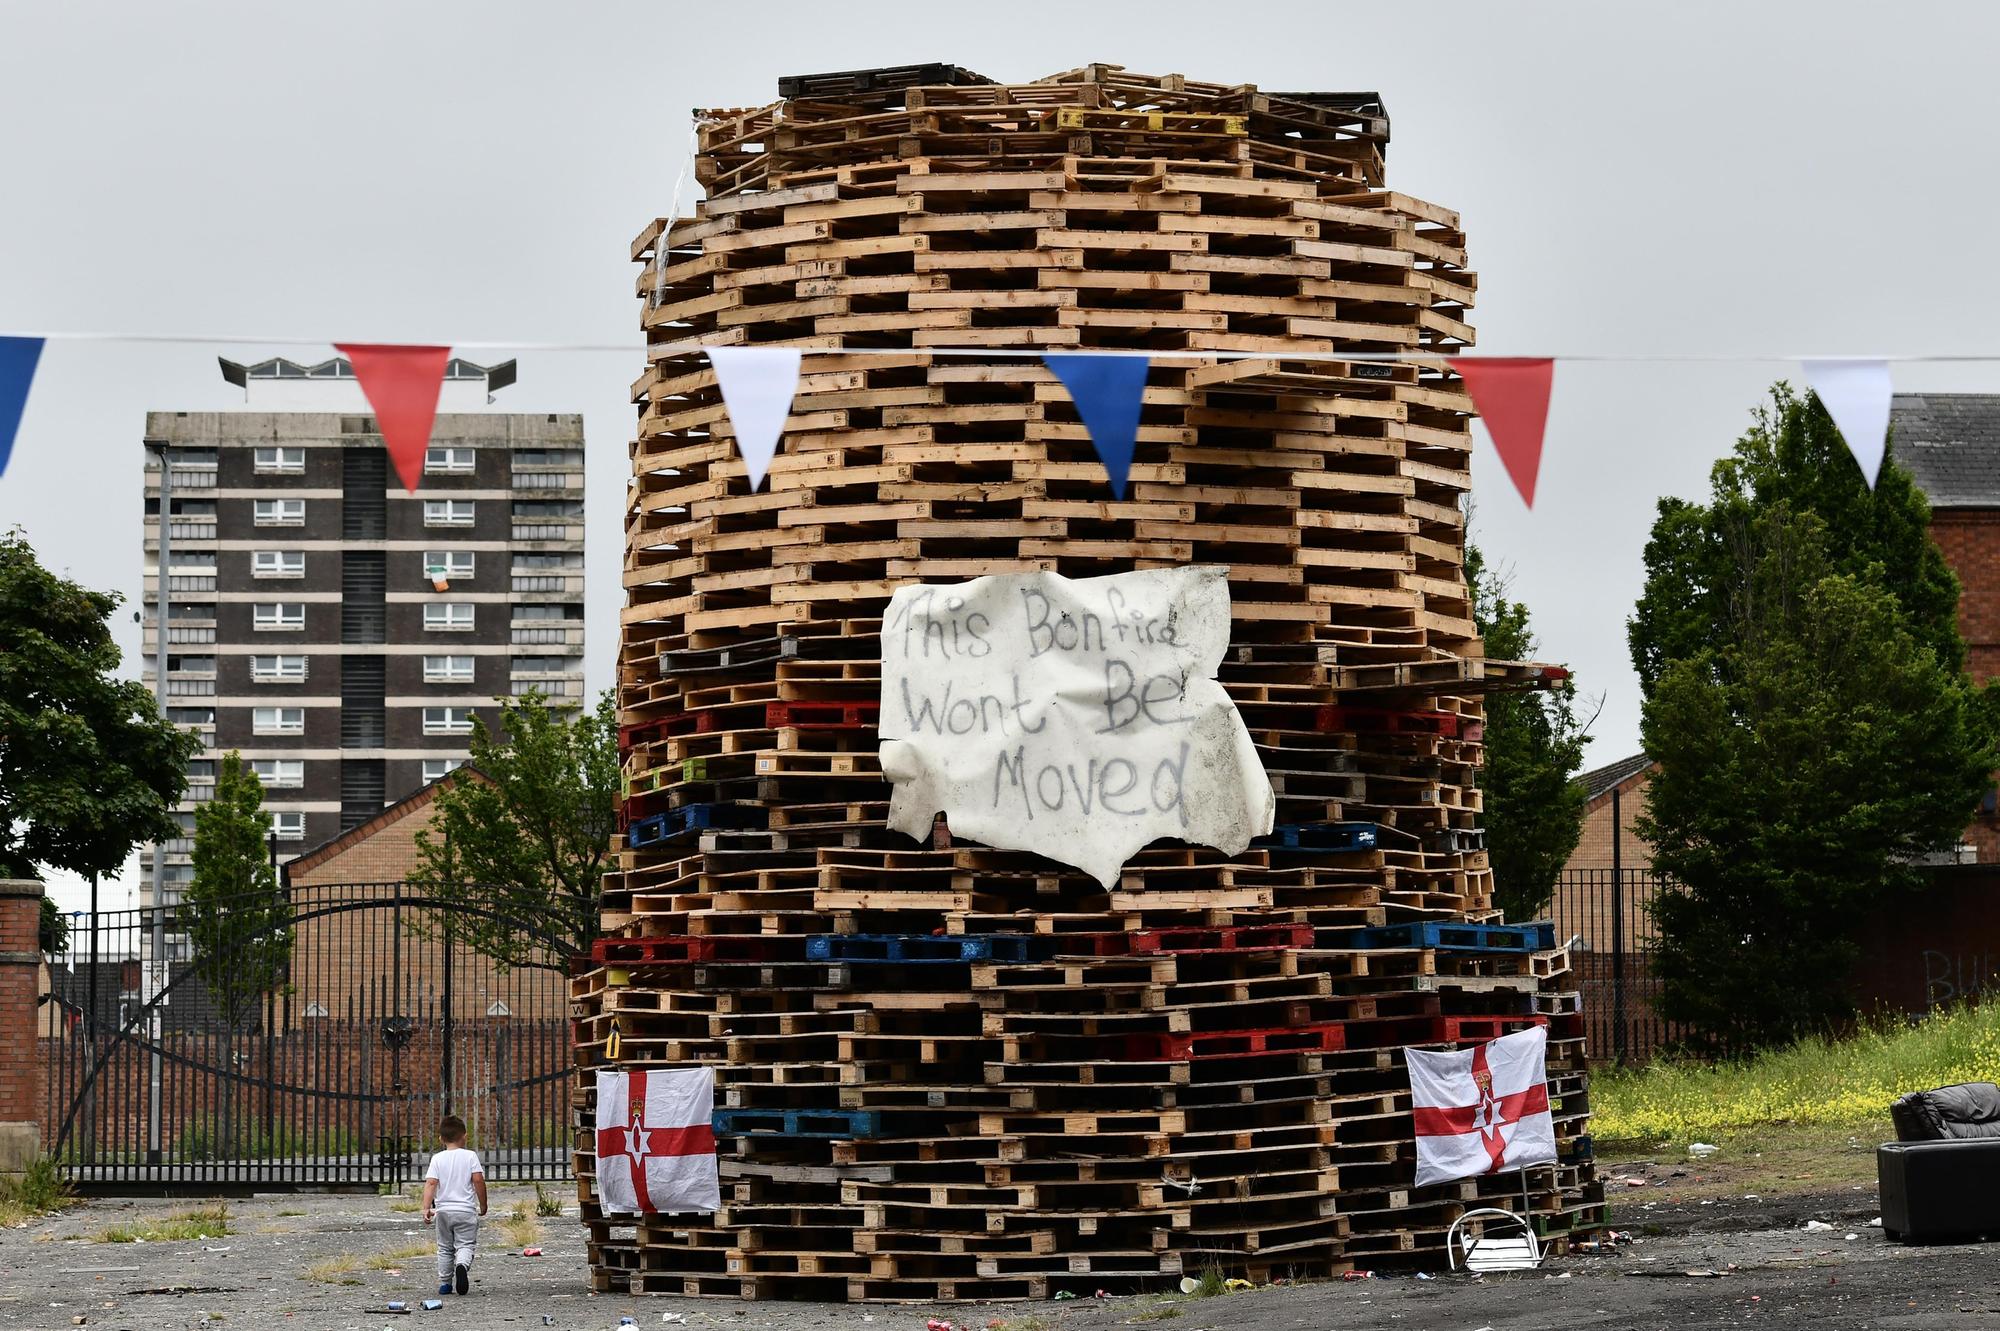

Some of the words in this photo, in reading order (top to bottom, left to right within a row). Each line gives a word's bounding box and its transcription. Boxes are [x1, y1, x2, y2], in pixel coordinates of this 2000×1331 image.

[892, 588, 992, 660] This
[1021, 586, 1190, 660] Bonfire
[901, 674, 1047, 737] Wont
[1095, 659, 1195, 736] Be
[993, 742, 1191, 829] Moved
[572, 1005, 584, 1015] W
